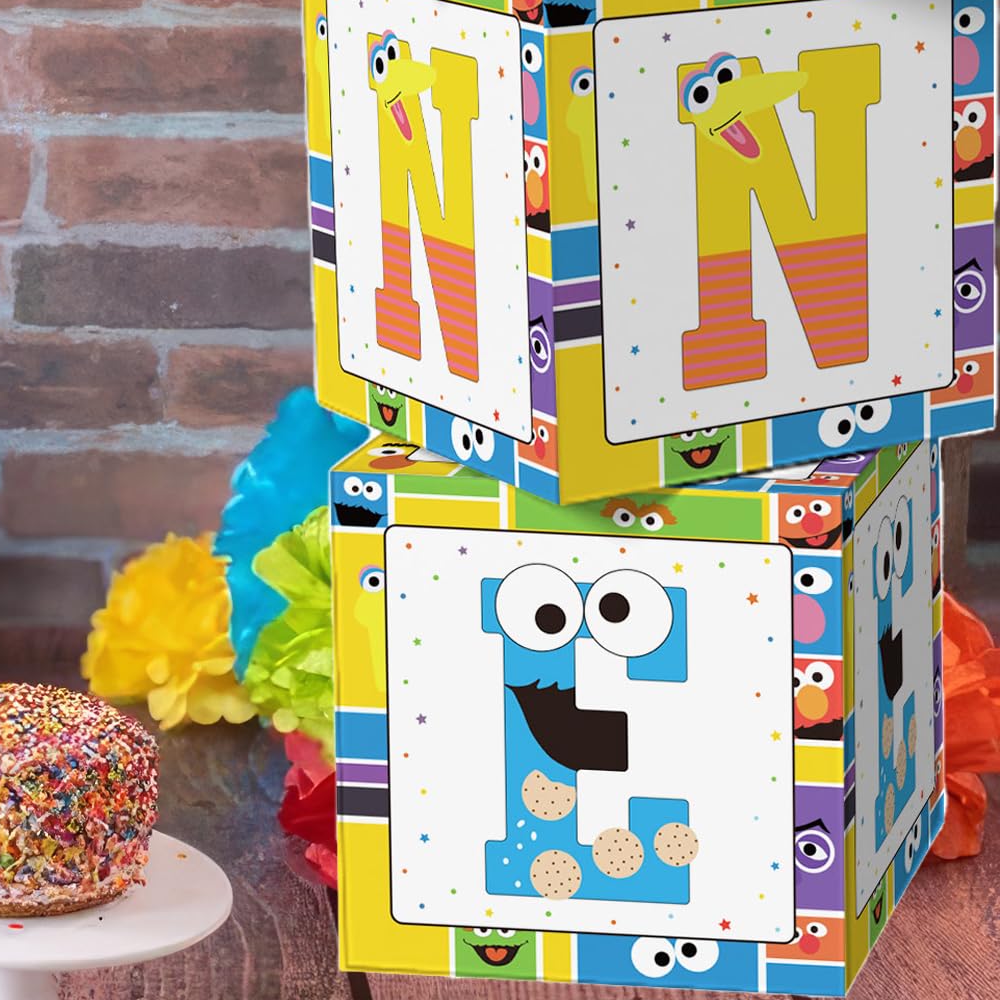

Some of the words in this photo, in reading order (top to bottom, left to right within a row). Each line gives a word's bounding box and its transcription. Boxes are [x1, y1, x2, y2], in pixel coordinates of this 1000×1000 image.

[366, 30, 480, 383] N
[677, 43, 882, 391] N
[481, 563, 695, 904] E
